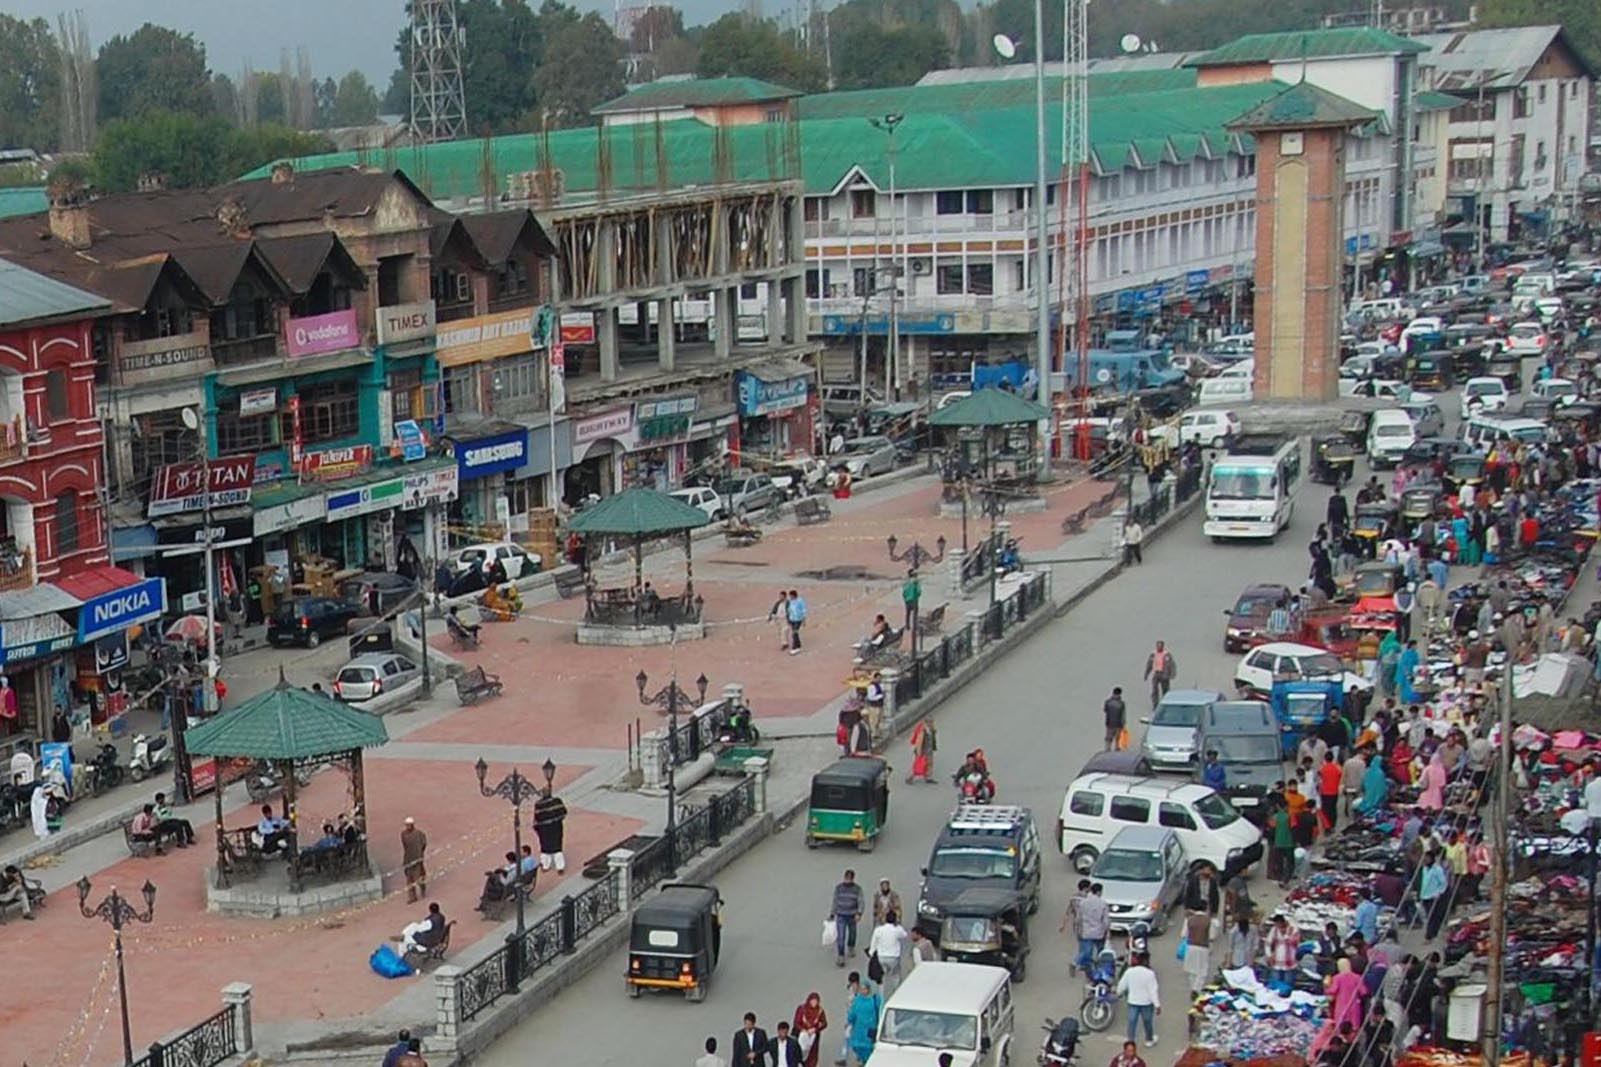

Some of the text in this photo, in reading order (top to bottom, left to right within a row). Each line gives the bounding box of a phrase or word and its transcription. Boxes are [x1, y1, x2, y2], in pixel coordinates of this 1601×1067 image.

[388, 312, 428, 332] TIMEX
[464, 441, 523, 467] SAMSUNG
[94, 591, 151, 623] NOKIA
